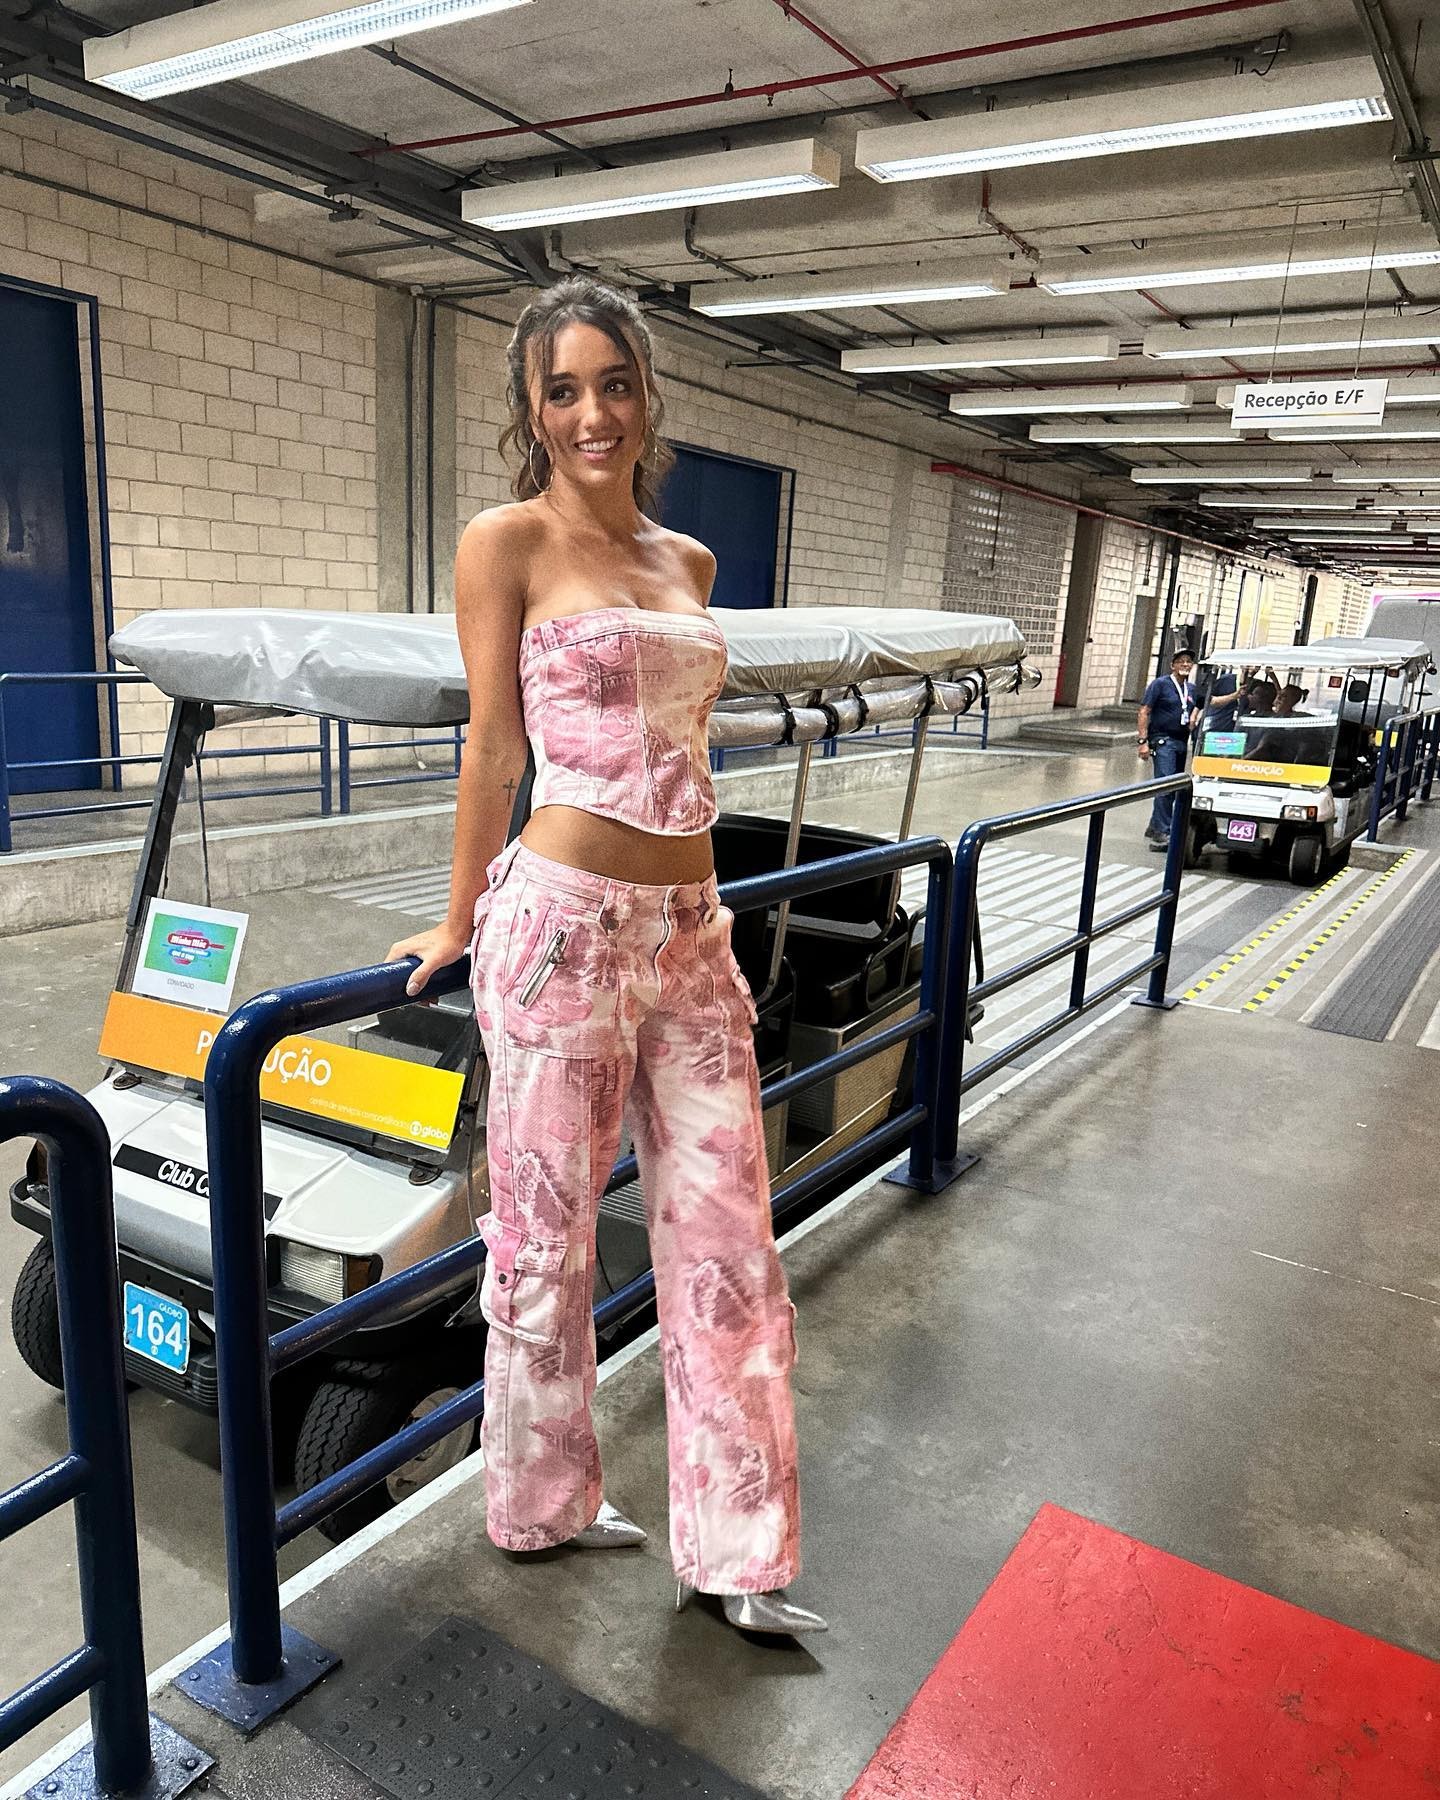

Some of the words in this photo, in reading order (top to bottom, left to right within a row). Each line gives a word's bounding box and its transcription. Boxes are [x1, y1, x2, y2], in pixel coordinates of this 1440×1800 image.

[1244, 391, 1328, 410] Recepção
[1335, 389, 1365, 404] E/F
[1231, 764, 1284, 776] PRODUÇÃO
[1230, 826, 1252, 838] 443
[196, 1031, 332, 1086] PUÇÃO
[421, 1125, 449, 1140] globo
[158, 1160, 195, 1188] Club
[131, 1303, 183, 1356] 164
